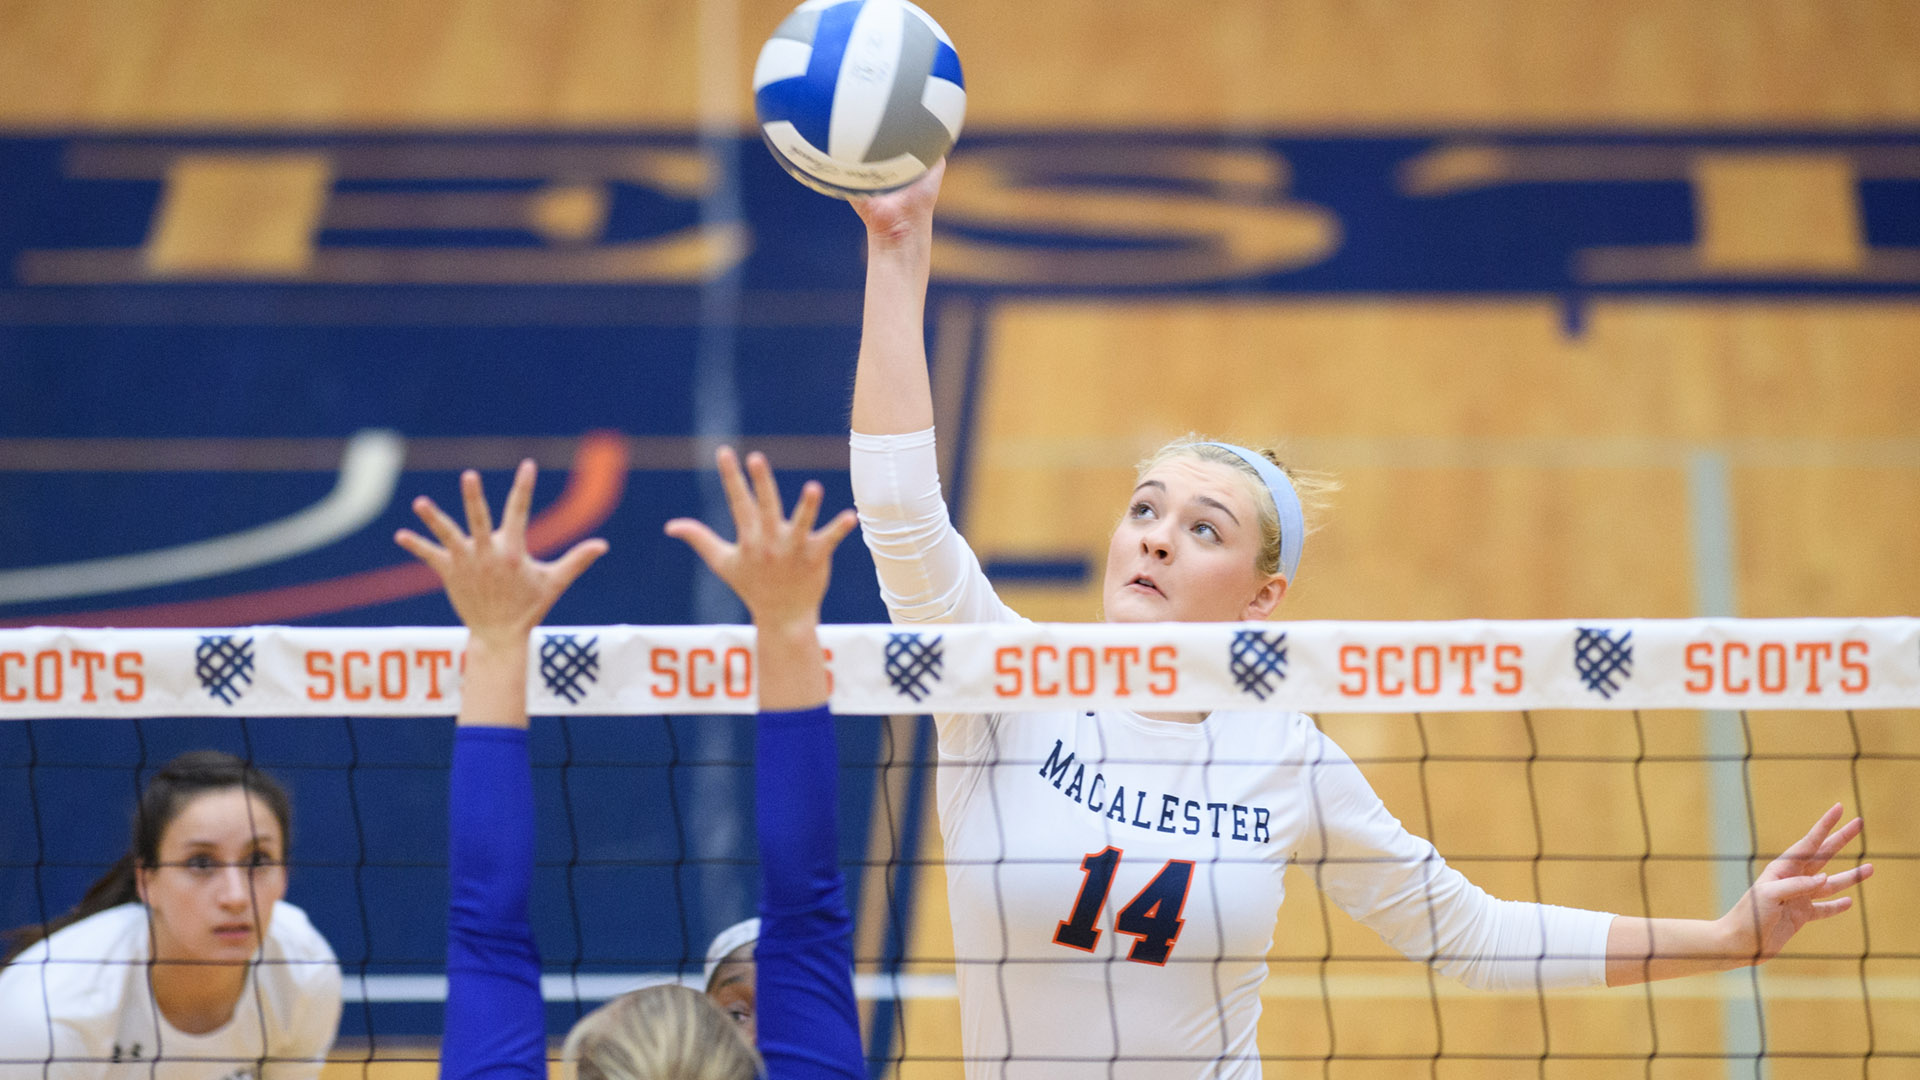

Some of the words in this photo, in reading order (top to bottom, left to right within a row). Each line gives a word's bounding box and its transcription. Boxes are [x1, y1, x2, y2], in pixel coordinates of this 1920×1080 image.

[304, 650, 467, 700] SCOT
[649, 647, 834, 698] SCO
[994, 644, 1178, 697] SCOTS
[1338, 643, 1524, 696] SCOTS
[1684, 640, 1870, 694] SCOTS
[1038, 738, 1271, 844] MACALESTER
[1051, 845, 1196, 967] 14
